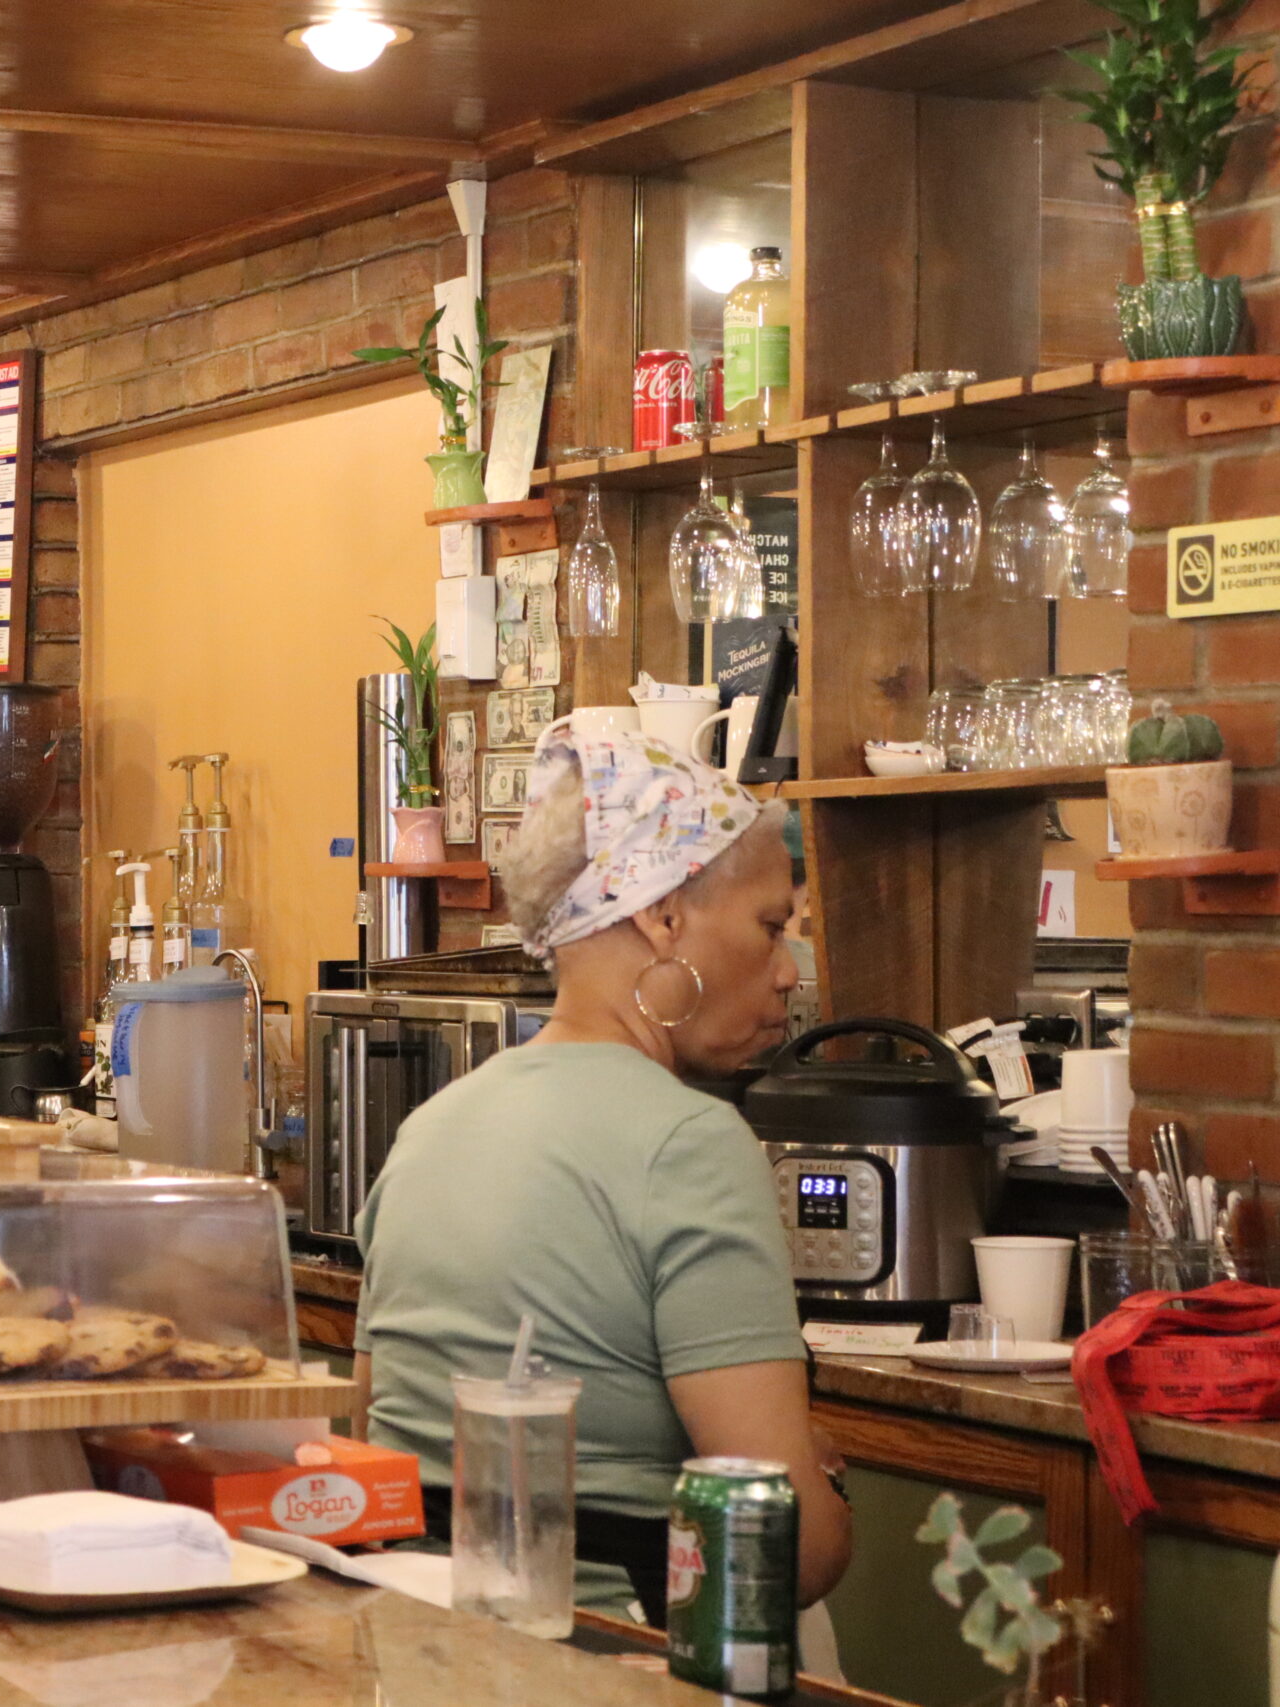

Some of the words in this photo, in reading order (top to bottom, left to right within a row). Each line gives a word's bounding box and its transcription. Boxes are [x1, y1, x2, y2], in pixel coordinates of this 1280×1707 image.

[1221, 543, 1238, 560] NO
[1221, 563, 1257, 576] INCLUDES
[728, 640, 766, 665] TEQUILA
[284, 1492, 357, 1523] Logan
